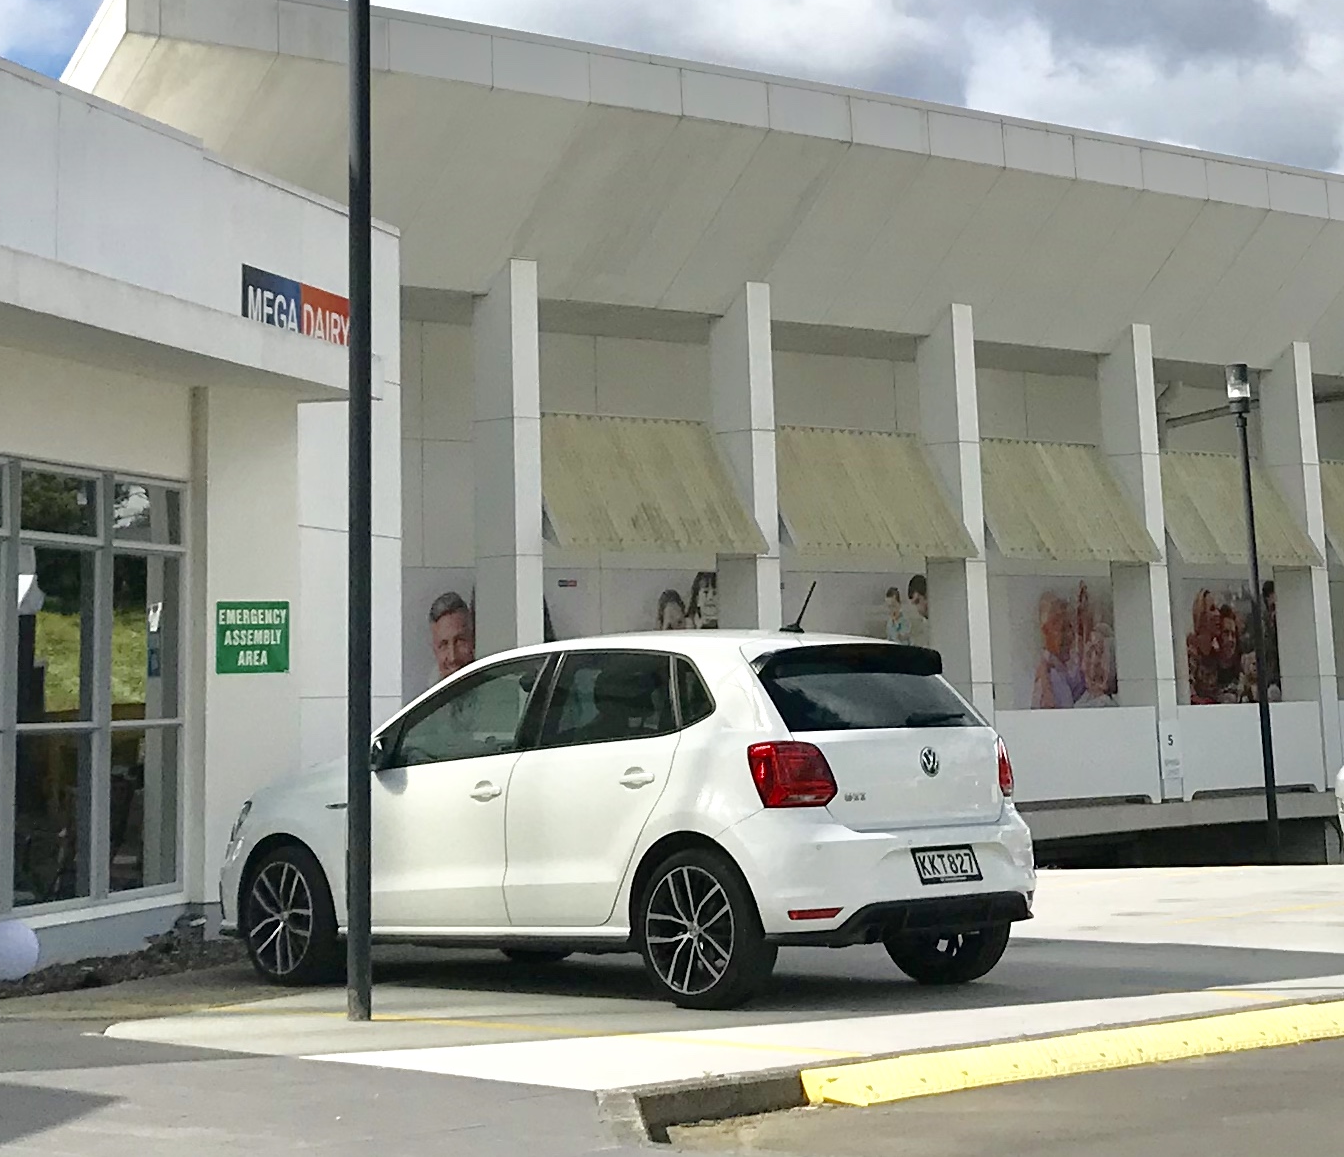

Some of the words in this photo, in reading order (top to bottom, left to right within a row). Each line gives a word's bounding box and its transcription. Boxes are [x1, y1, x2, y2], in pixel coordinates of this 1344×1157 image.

[302, 303, 350, 346] DAIRY
[218, 609, 286, 625] EMERGENCY
[224, 630, 282, 645] ASSEMBLY
[237, 650, 268, 666] AREA
[1167, 734, 1174, 746] 5
[917, 852, 974, 876] KKT827
